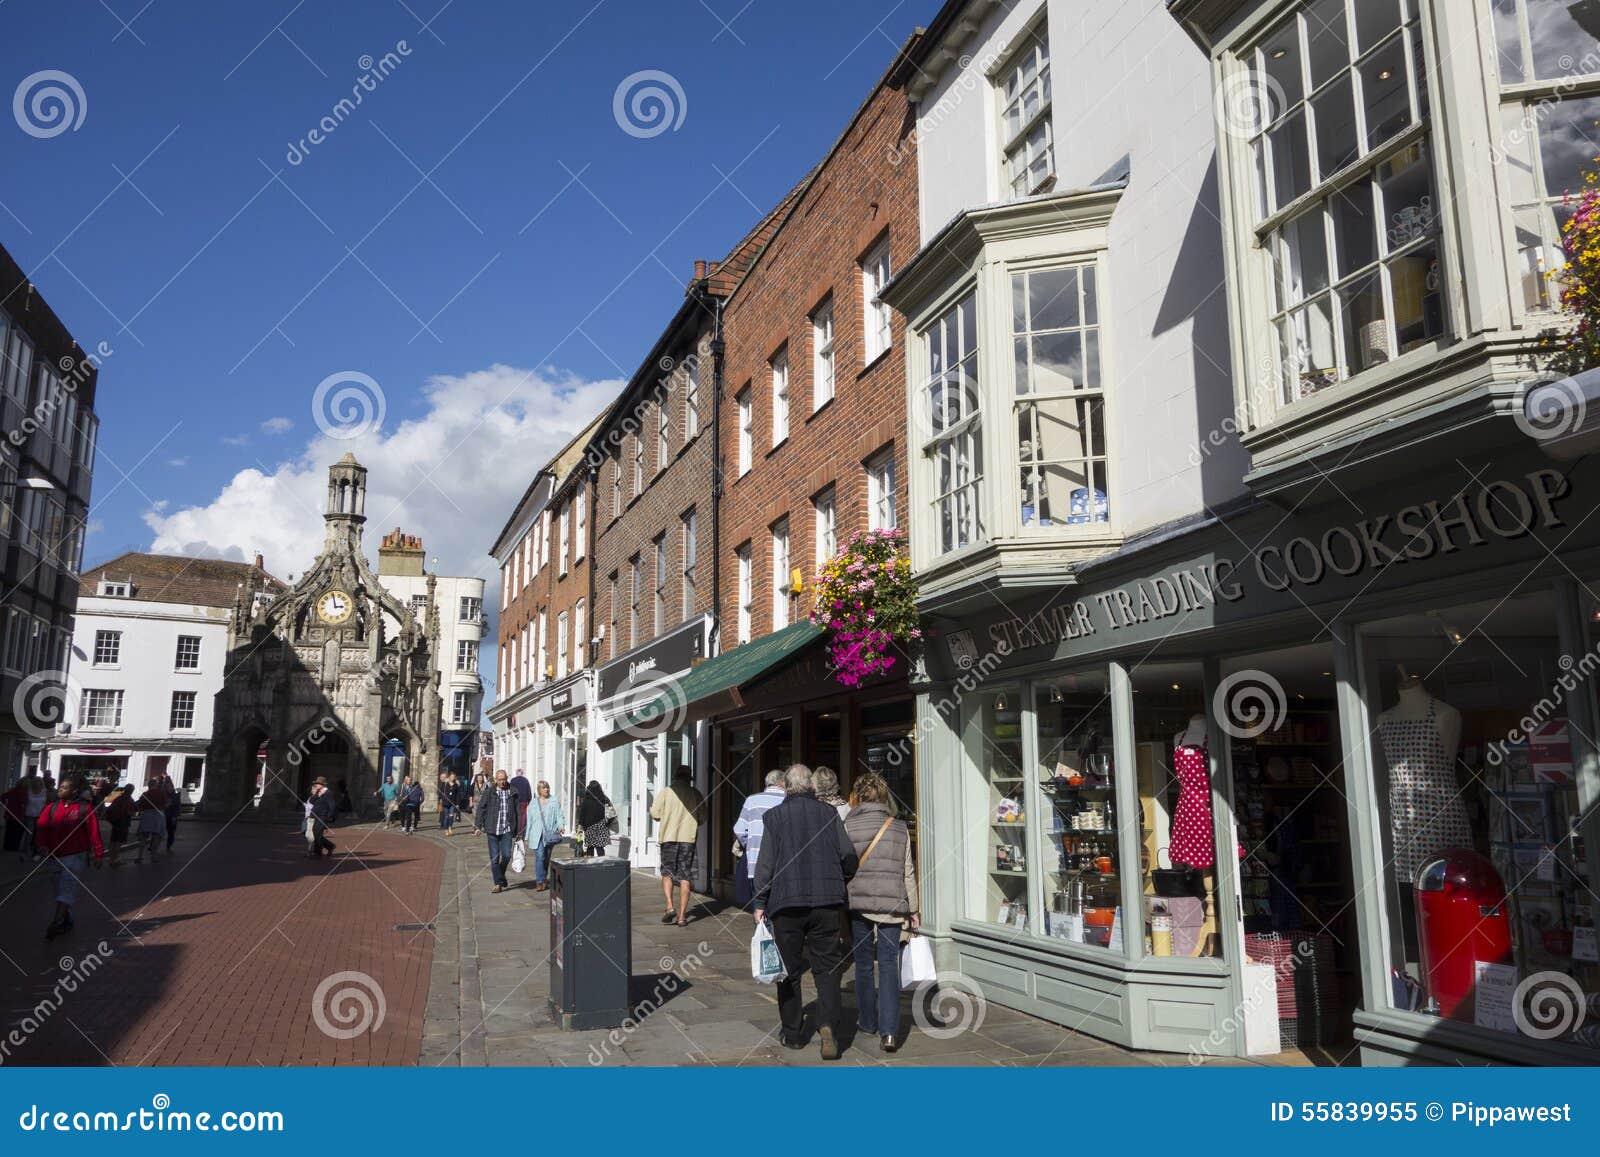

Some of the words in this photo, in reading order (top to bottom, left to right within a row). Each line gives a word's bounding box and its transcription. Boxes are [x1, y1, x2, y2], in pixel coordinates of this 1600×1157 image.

[988, 601, 1095, 651] STEAMER
[1097, 560, 1244, 629] TRADING
[1255, 469, 1571, 590] COOKSHOP
